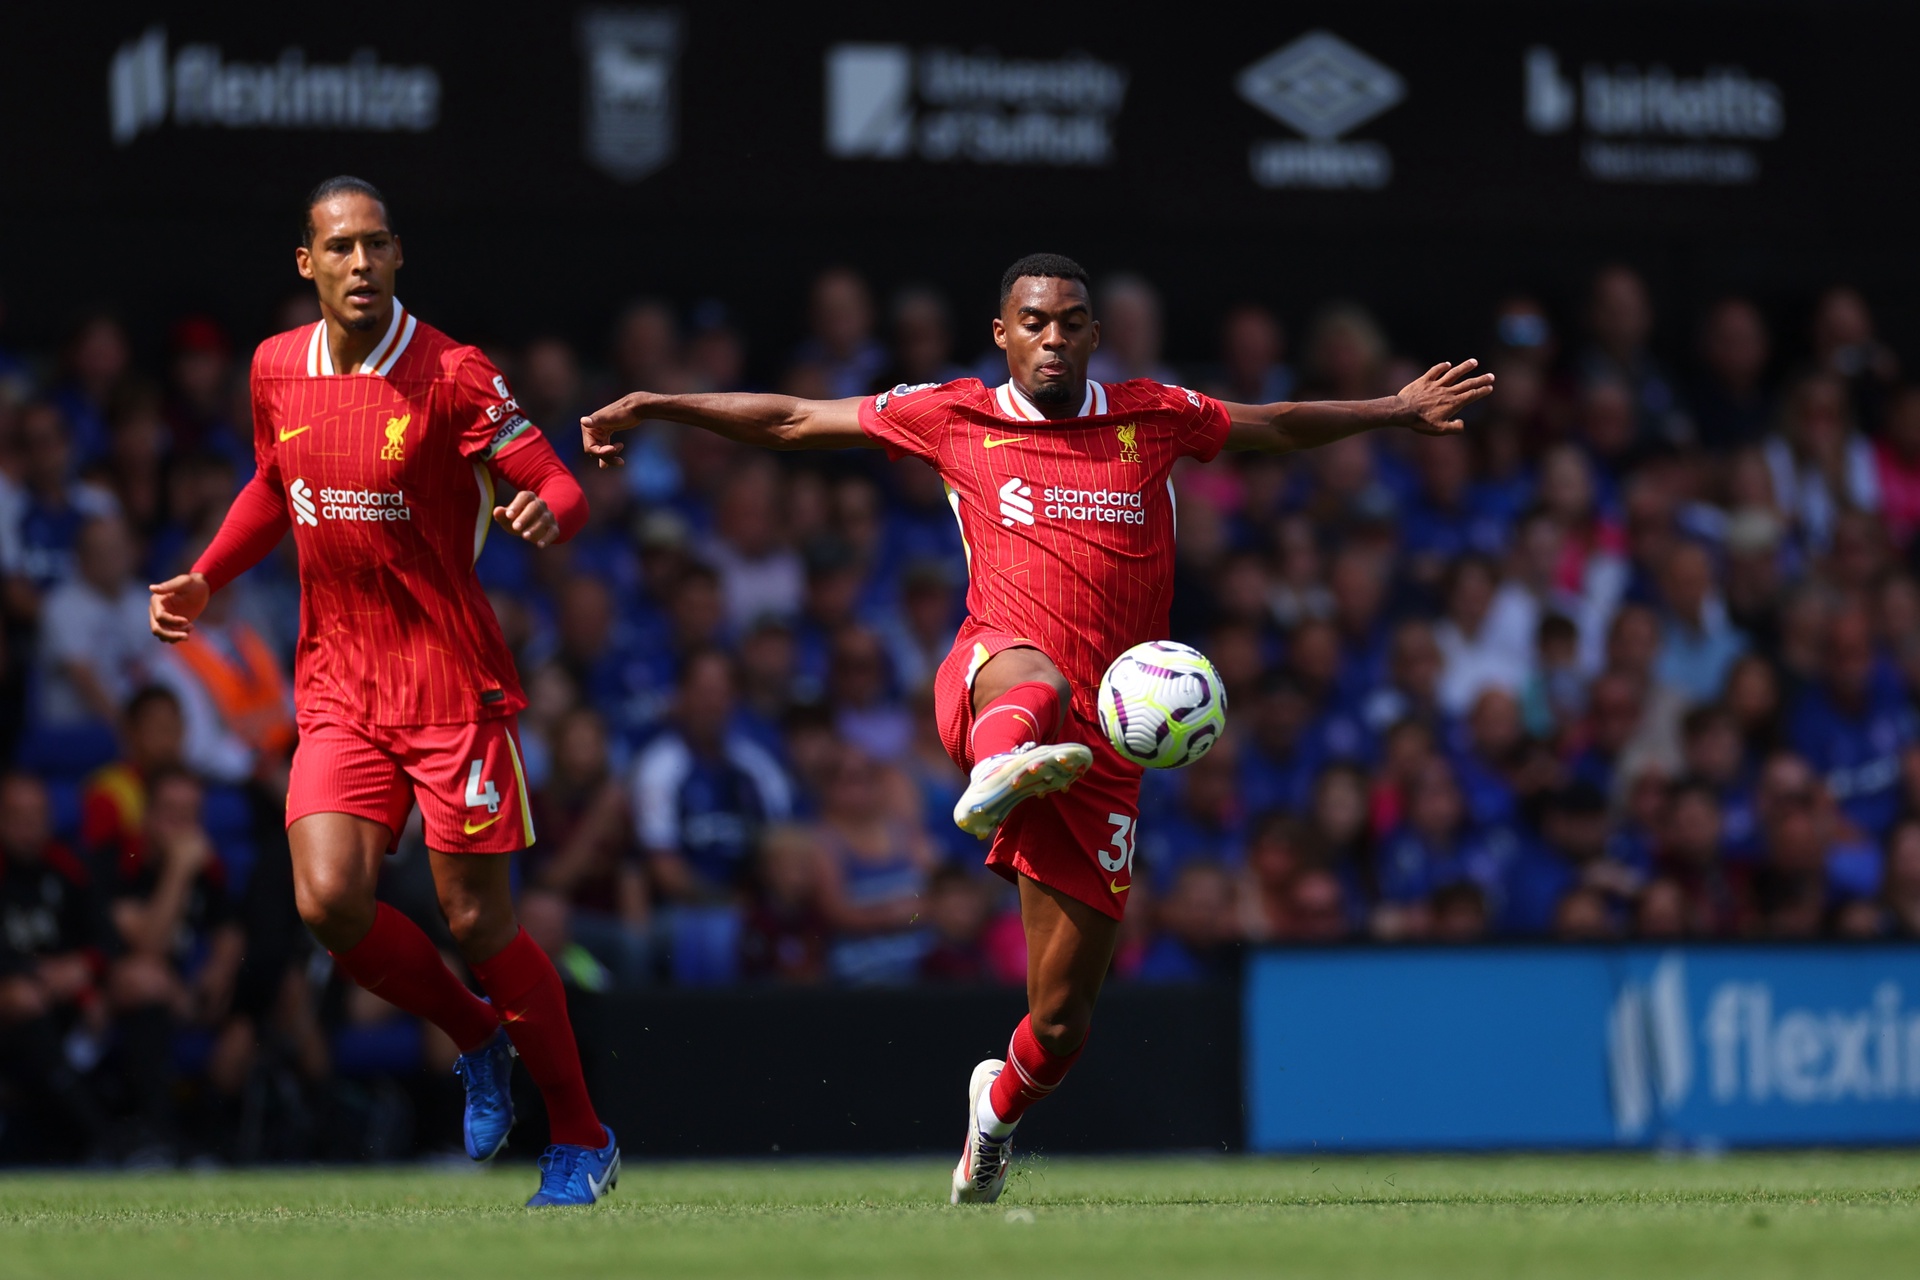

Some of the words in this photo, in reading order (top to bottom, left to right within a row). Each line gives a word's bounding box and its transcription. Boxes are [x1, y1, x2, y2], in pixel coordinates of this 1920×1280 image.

[320, 486, 403, 506] standard
[1043, 486, 1141, 508] standard
[322, 503, 411, 521] chartered
[1044, 503, 1145, 525] chartered
[465, 759, 500, 813] 4
